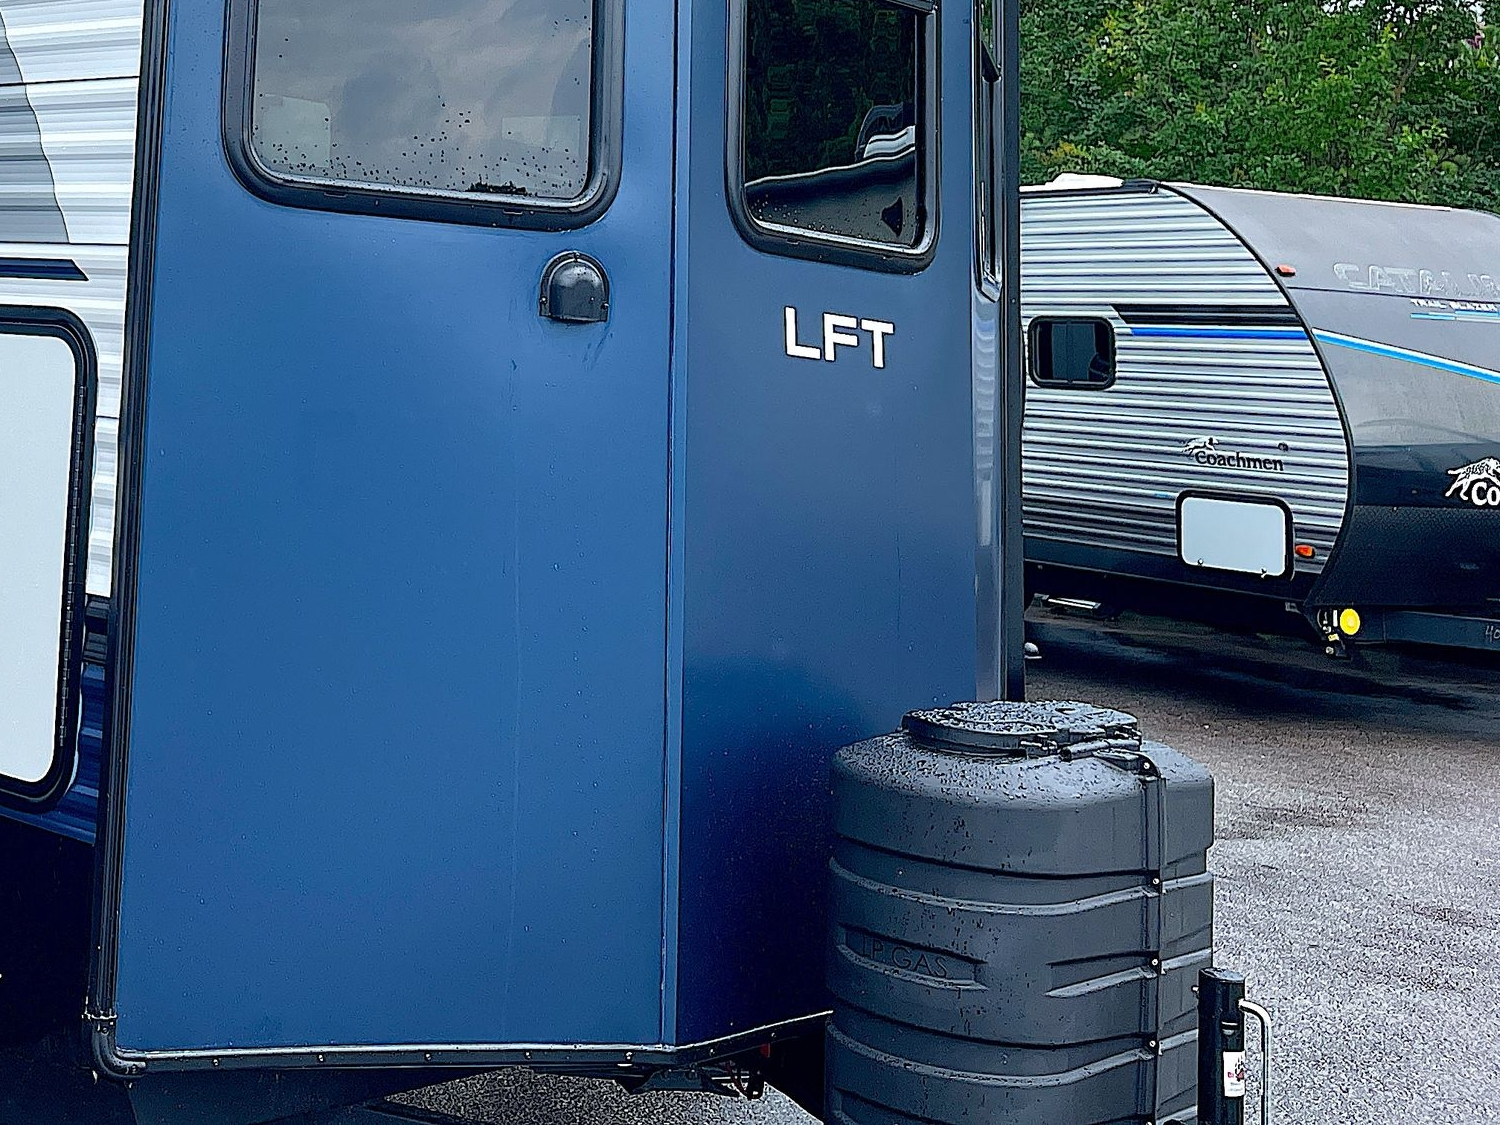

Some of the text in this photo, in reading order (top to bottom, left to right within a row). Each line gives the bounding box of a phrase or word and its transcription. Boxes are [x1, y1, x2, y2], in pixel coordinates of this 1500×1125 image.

[784, 305, 895, 369] LFT
[1195, 451, 1284, 471] Coachmen
[1471, 481, 1500, 506] Co
[891, 945, 948, 978] GAS
